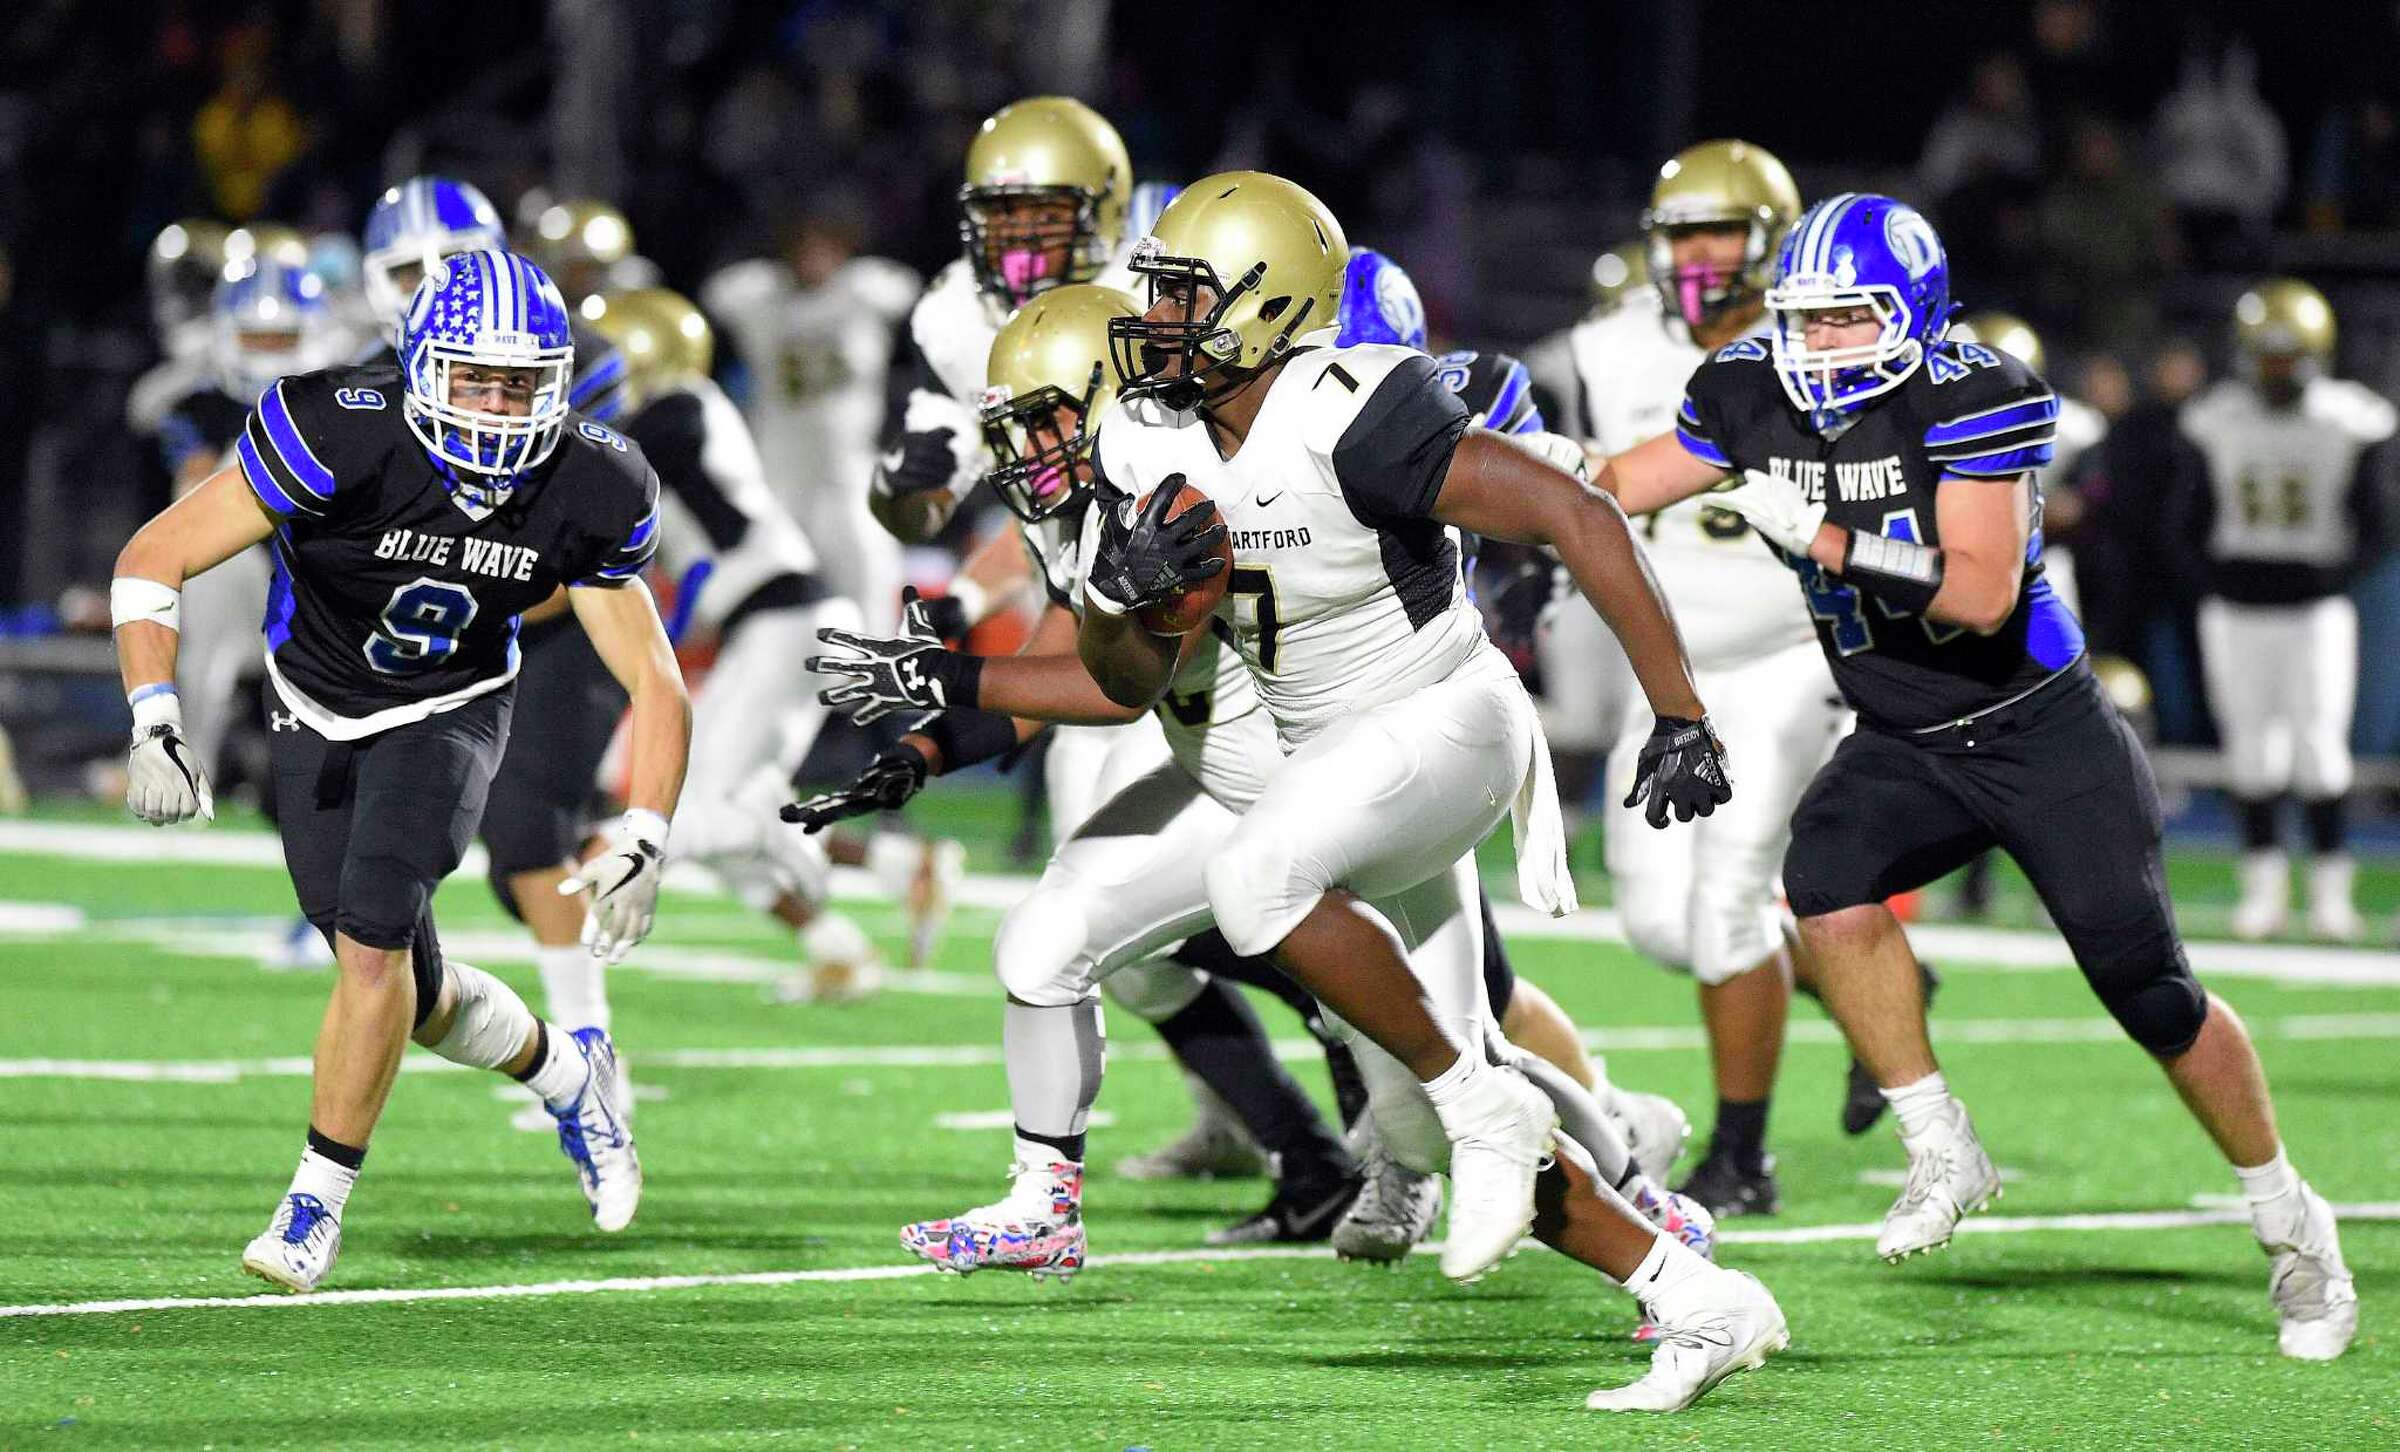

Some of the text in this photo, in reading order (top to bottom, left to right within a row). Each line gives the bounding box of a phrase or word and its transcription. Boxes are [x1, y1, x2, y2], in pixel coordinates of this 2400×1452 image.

[1310, 361, 1360, 394] 7
[1926, 342, 2002, 385] 44
[334, 387, 387, 410] 9
[578, 421, 628, 453] 9
[1835, 454, 1907, 501] WAVE
[374, 528, 539, 582] BLUE WAVE
[1229, 526, 1312, 550] ARTFORD
[362, 576, 480, 676] 9
[1226, 561, 1283, 678] 7
